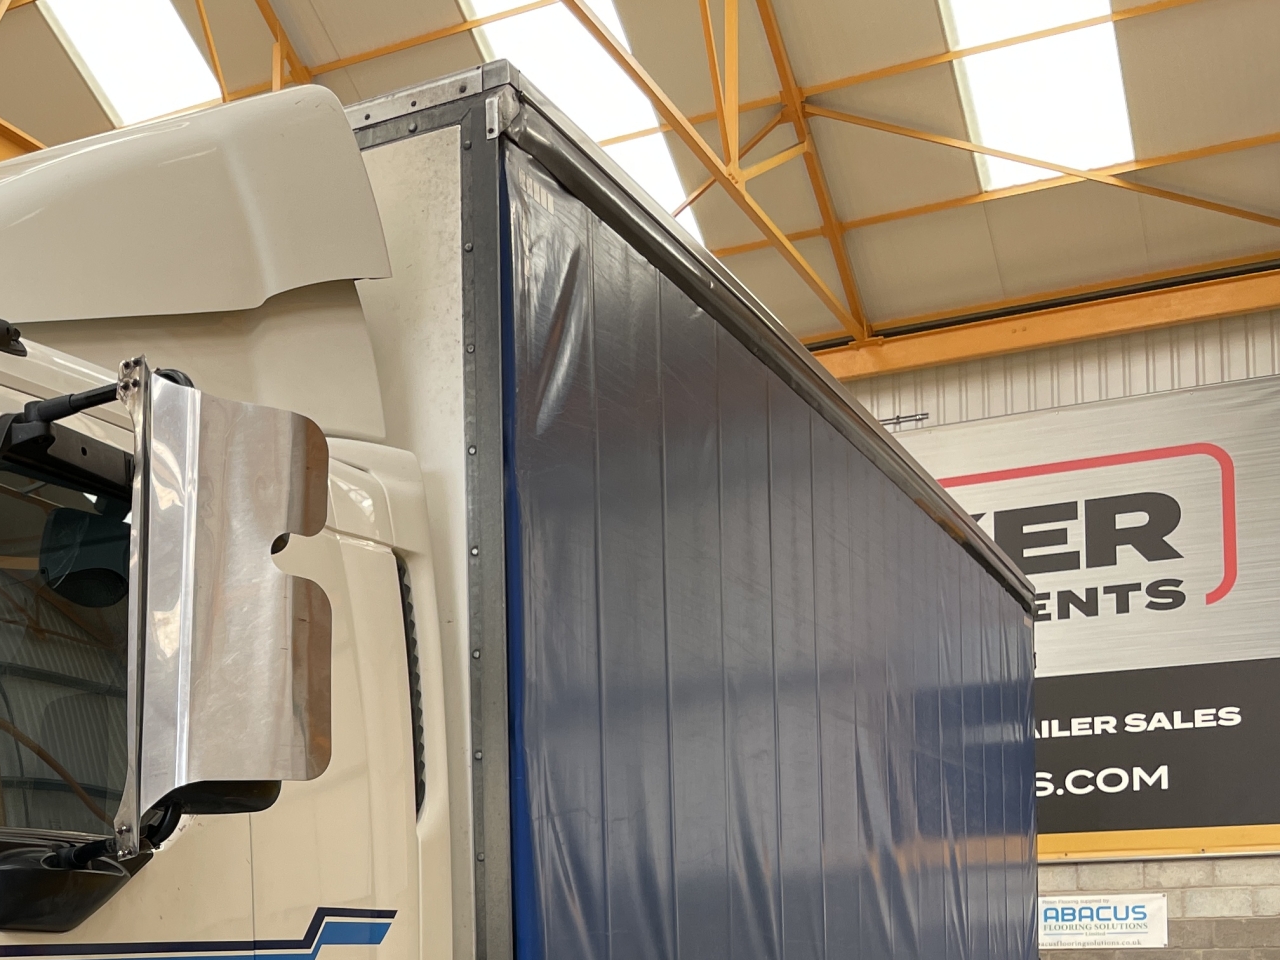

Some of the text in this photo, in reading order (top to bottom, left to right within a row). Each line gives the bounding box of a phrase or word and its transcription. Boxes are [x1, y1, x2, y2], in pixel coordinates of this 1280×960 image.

[970, 491, 1185, 575] ER
[1124, 706, 1242, 732] SALES
[1035, 765, 1169, 797] S.COM
[1043, 905, 1147, 922] ABACUS
[1043, 922, 1148, 932] FLOORING SOLUTIONS
